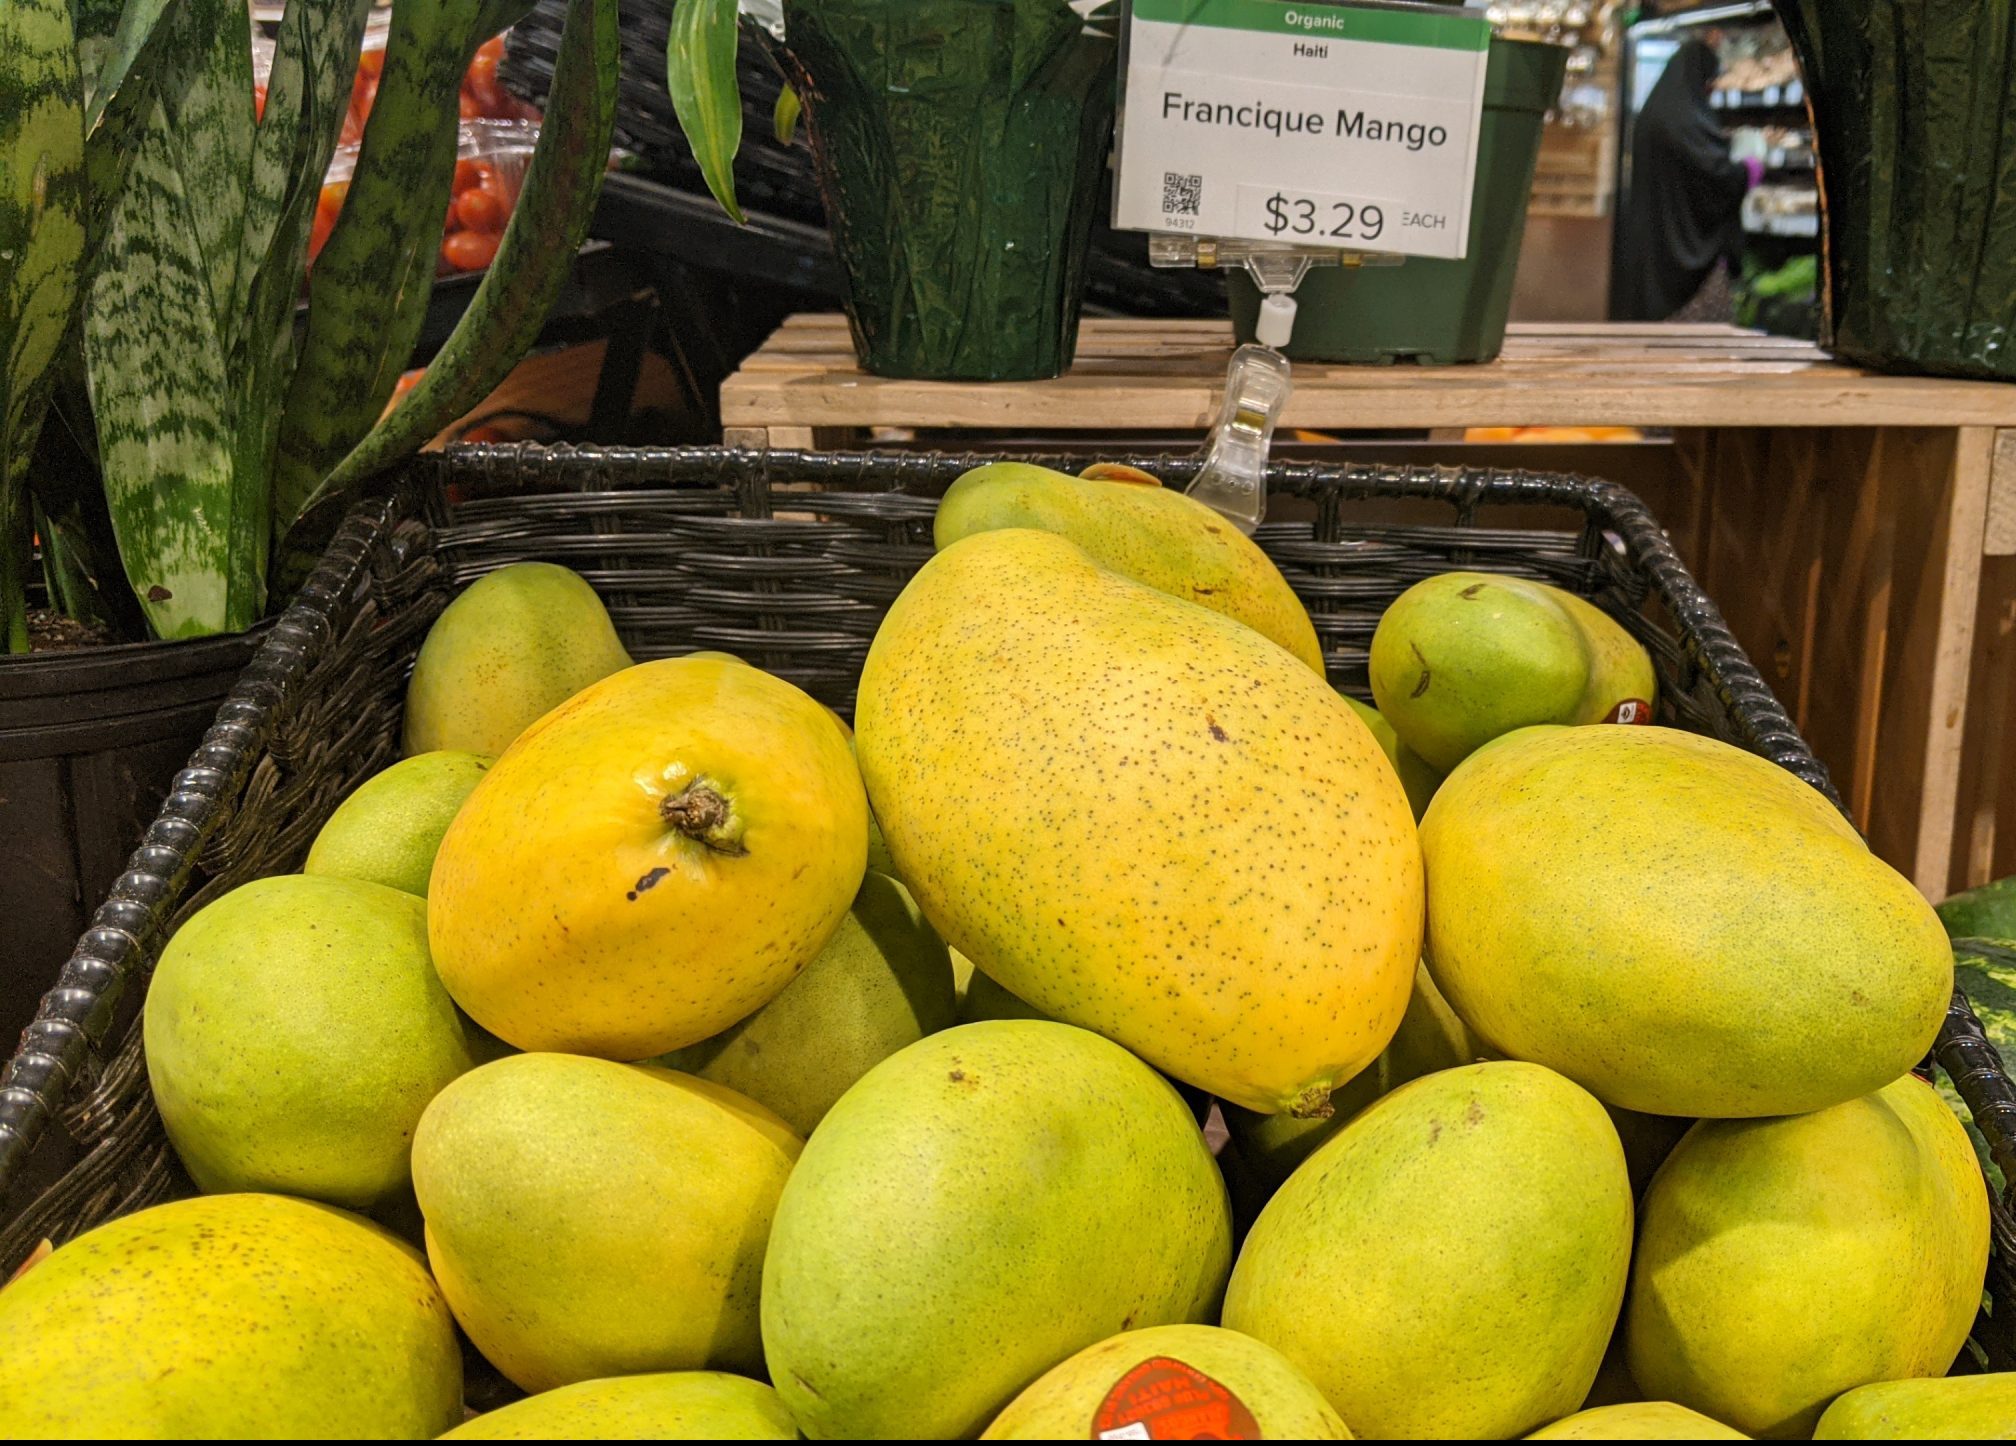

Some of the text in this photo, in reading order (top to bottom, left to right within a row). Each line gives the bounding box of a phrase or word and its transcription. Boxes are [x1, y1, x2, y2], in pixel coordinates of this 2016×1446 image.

[1284, 10, 1345, 31] Organic
[1293, 42, 1328, 59] Haiti
[1162, 92, 1447, 151] Francique Mango
[1165, 217, 1195, 229] 94312
[1264, 192, 1446, 241] $3.29 EACH
